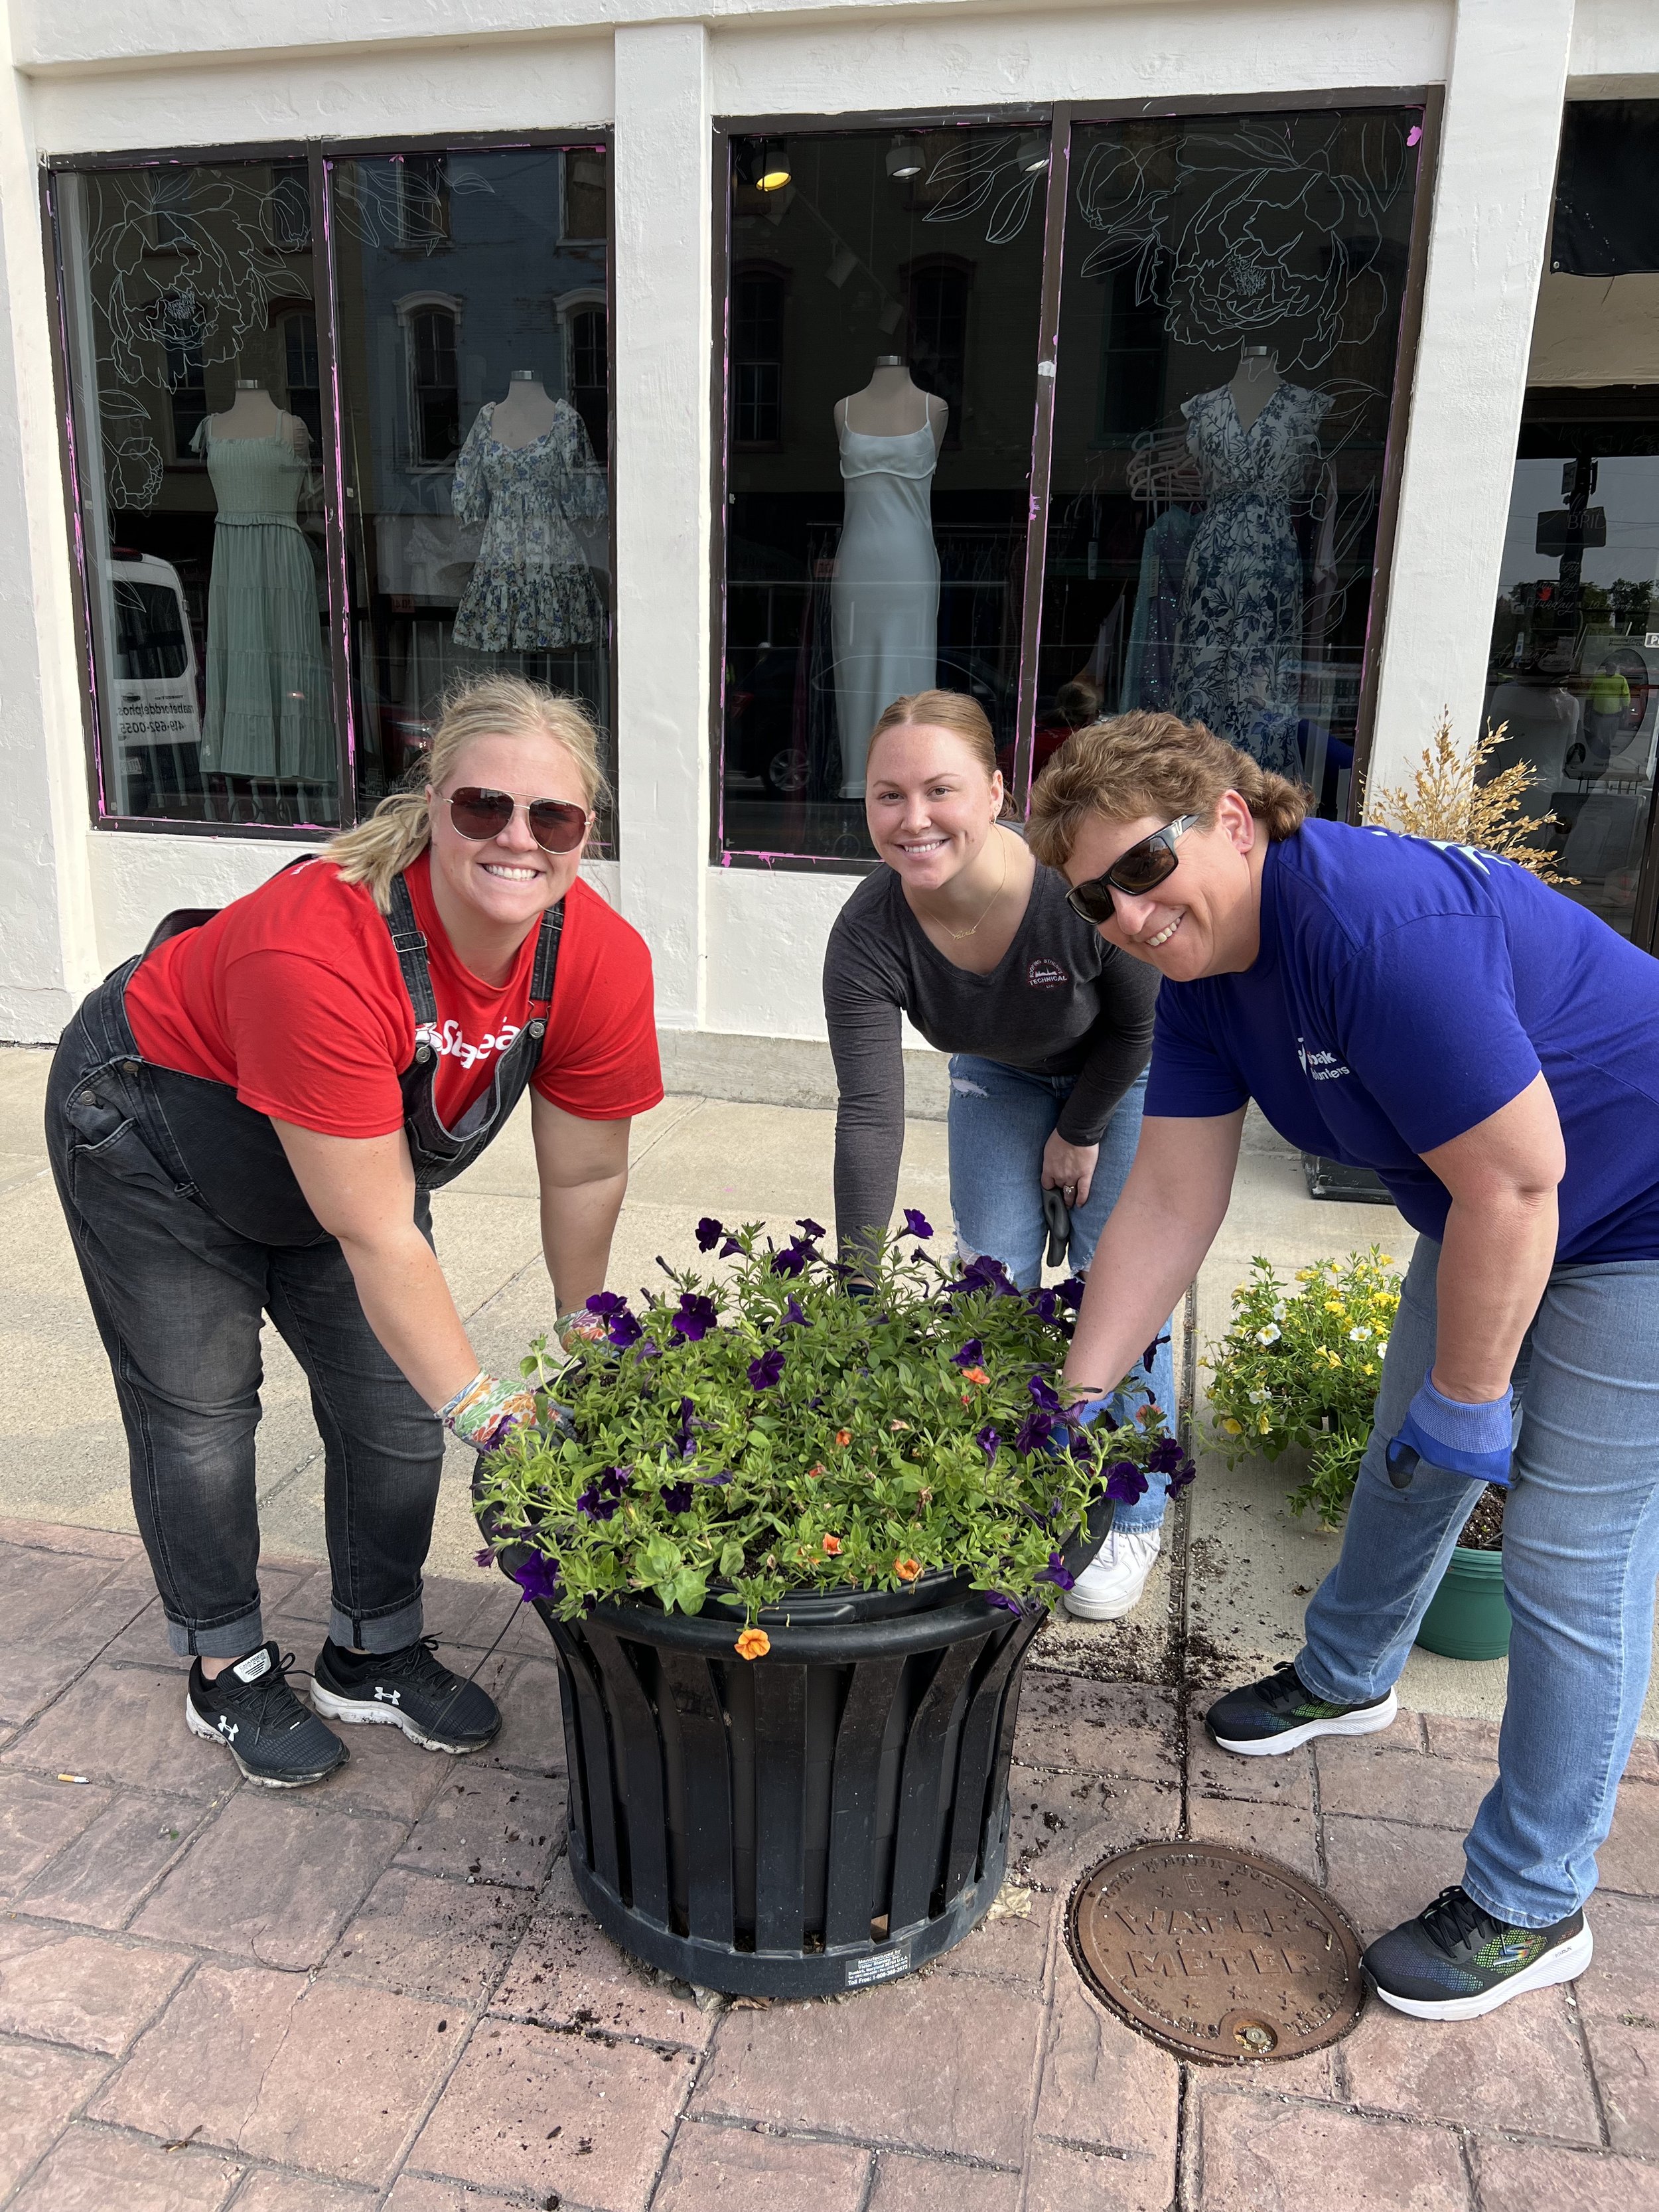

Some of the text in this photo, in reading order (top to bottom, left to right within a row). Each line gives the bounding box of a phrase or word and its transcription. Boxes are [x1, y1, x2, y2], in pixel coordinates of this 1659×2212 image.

[1029, 976, 1068, 986] TECHNICAL
[1116, 1907, 1300, 1936] WATER
[1127, 1947, 1320, 1977] METER
